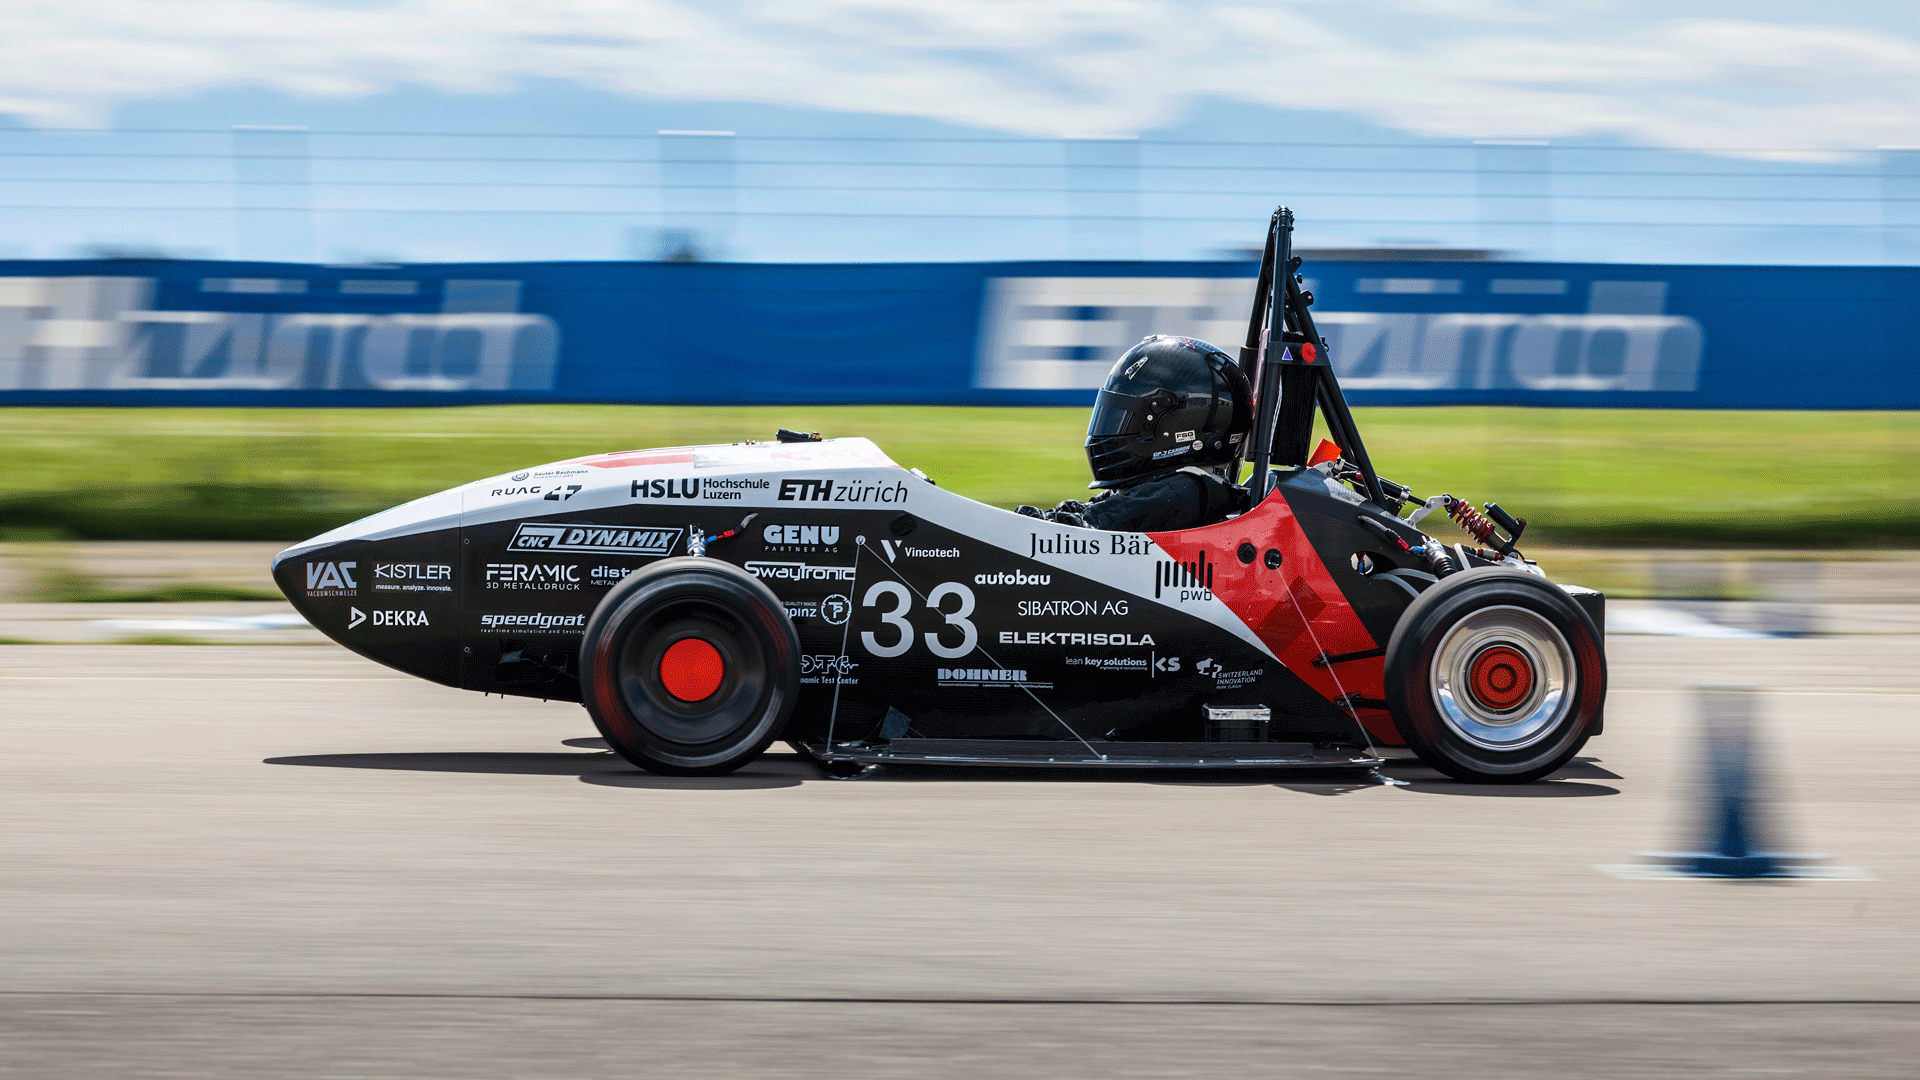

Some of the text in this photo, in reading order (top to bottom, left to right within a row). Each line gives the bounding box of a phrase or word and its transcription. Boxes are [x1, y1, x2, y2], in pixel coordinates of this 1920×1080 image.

[630, 478, 700, 499] HSLU
[703, 478, 770, 489] Hochschule
[778, 479, 908, 503] ETH zürich
[491, 486, 541, 497] RUAG
[703, 489, 741, 500] Luzern
[517, 529, 674, 548] CNC DYNAMIX
[763, 524, 840, 545] GENU
[905, 547, 960, 558] Vincotech
[1029, 532, 1155, 559] Julius Bär
[306, 561, 357, 590] VAC
[374, 563, 452, 580] KISTLER
[486, 564, 581, 582] FERAMIC
[974, 569, 1051, 585] autobau
[403, 584, 426, 592] analyze.
[503, 582, 580, 590] METALLDRUCK
[1181, 588, 1212, 603] pwb
[1017, 600, 1129, 616] SIBATRON AG
[373, 610, 430, 626] DEKRA
[480, 612, 586, 629] speedgoat
[860, 580, 978, 659] 33
[999, 631, 1156, 646] ELEKTRISOLA
[1066, 656, 1147, 667] lean key solutions
[821, 676, 835, 684] Test
[837, 676, 859, 684] Center
[937, 668, 1028, 681] DOHNER
[1217, 668, 1264, 679] SWITZERLAND
[1216, 677, 1256, 686] INNOVATION
